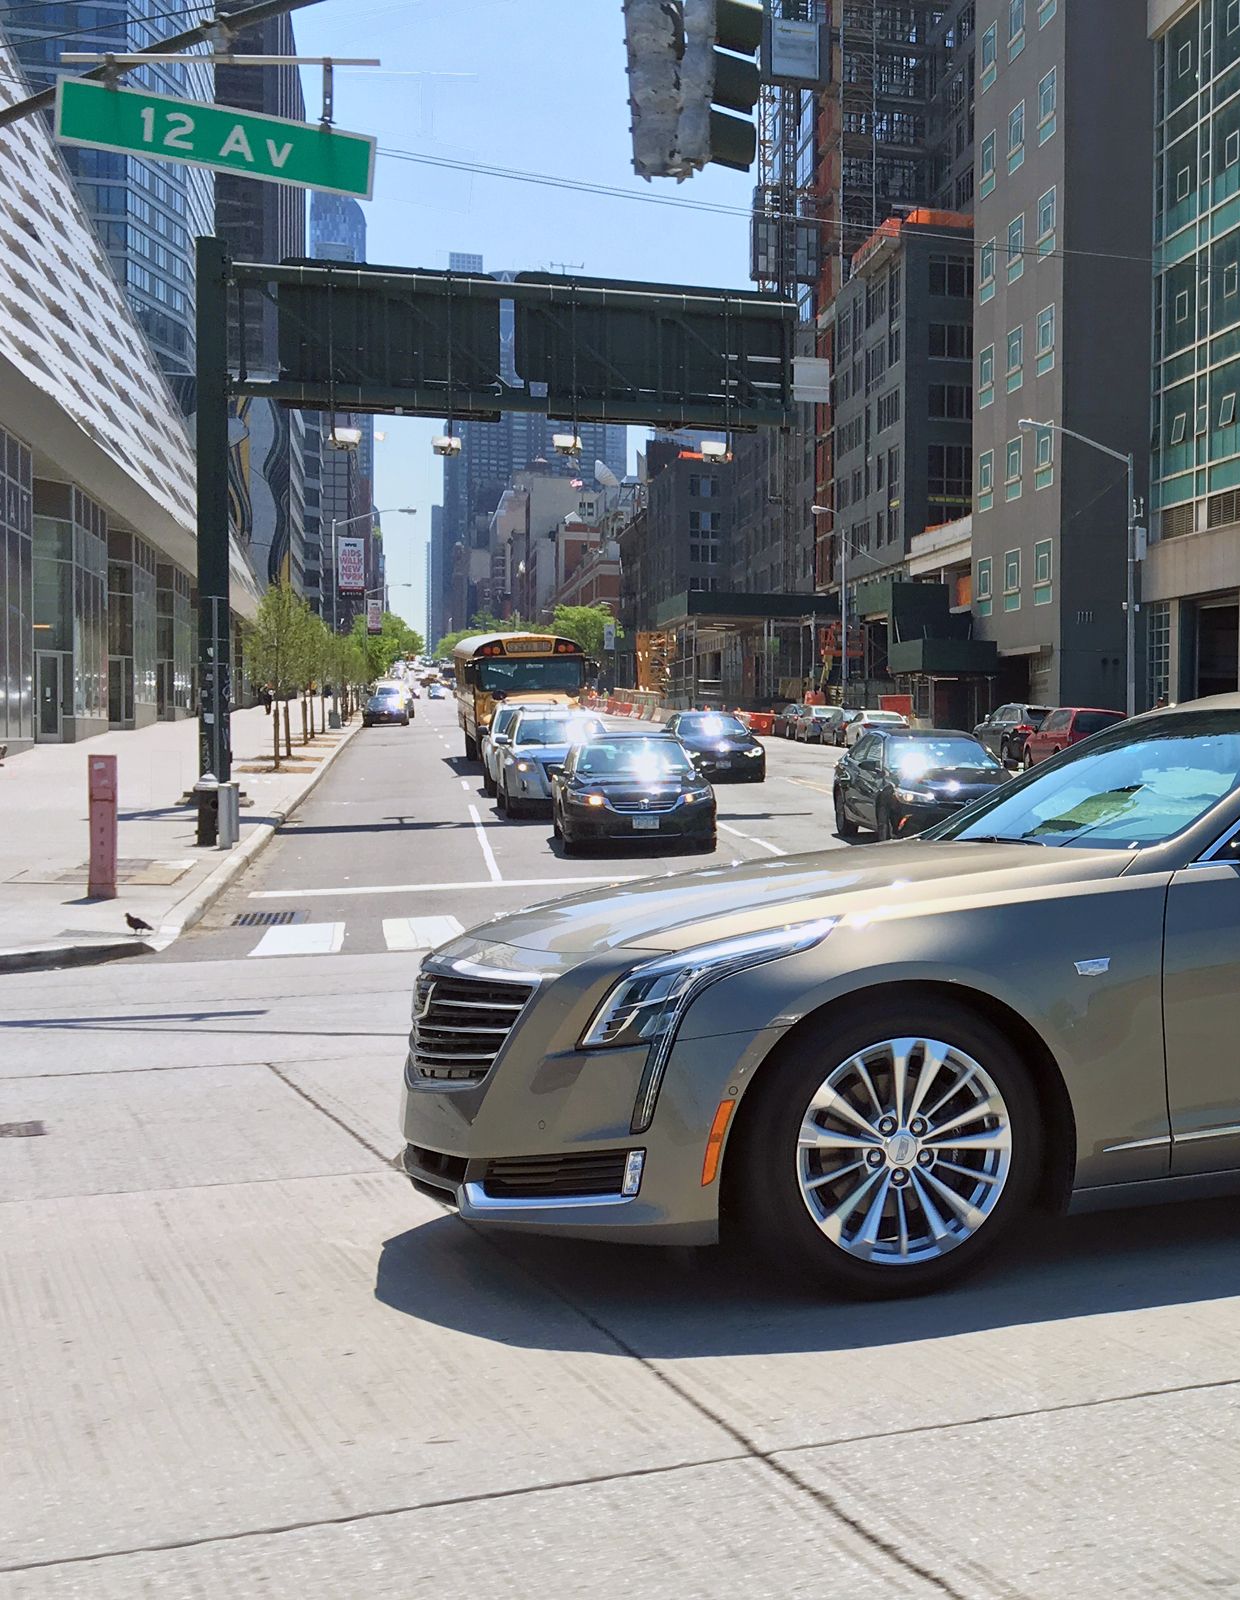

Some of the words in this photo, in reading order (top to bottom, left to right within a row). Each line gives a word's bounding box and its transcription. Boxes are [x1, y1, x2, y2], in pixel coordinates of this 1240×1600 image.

[140, 107, 195, 150] 12
[218, 124, 294, 168] Av
[341, 549, 361, 557] AIDS
[340, 556, 363, 565] WALK
[341, 565, 361, 573] NEW
